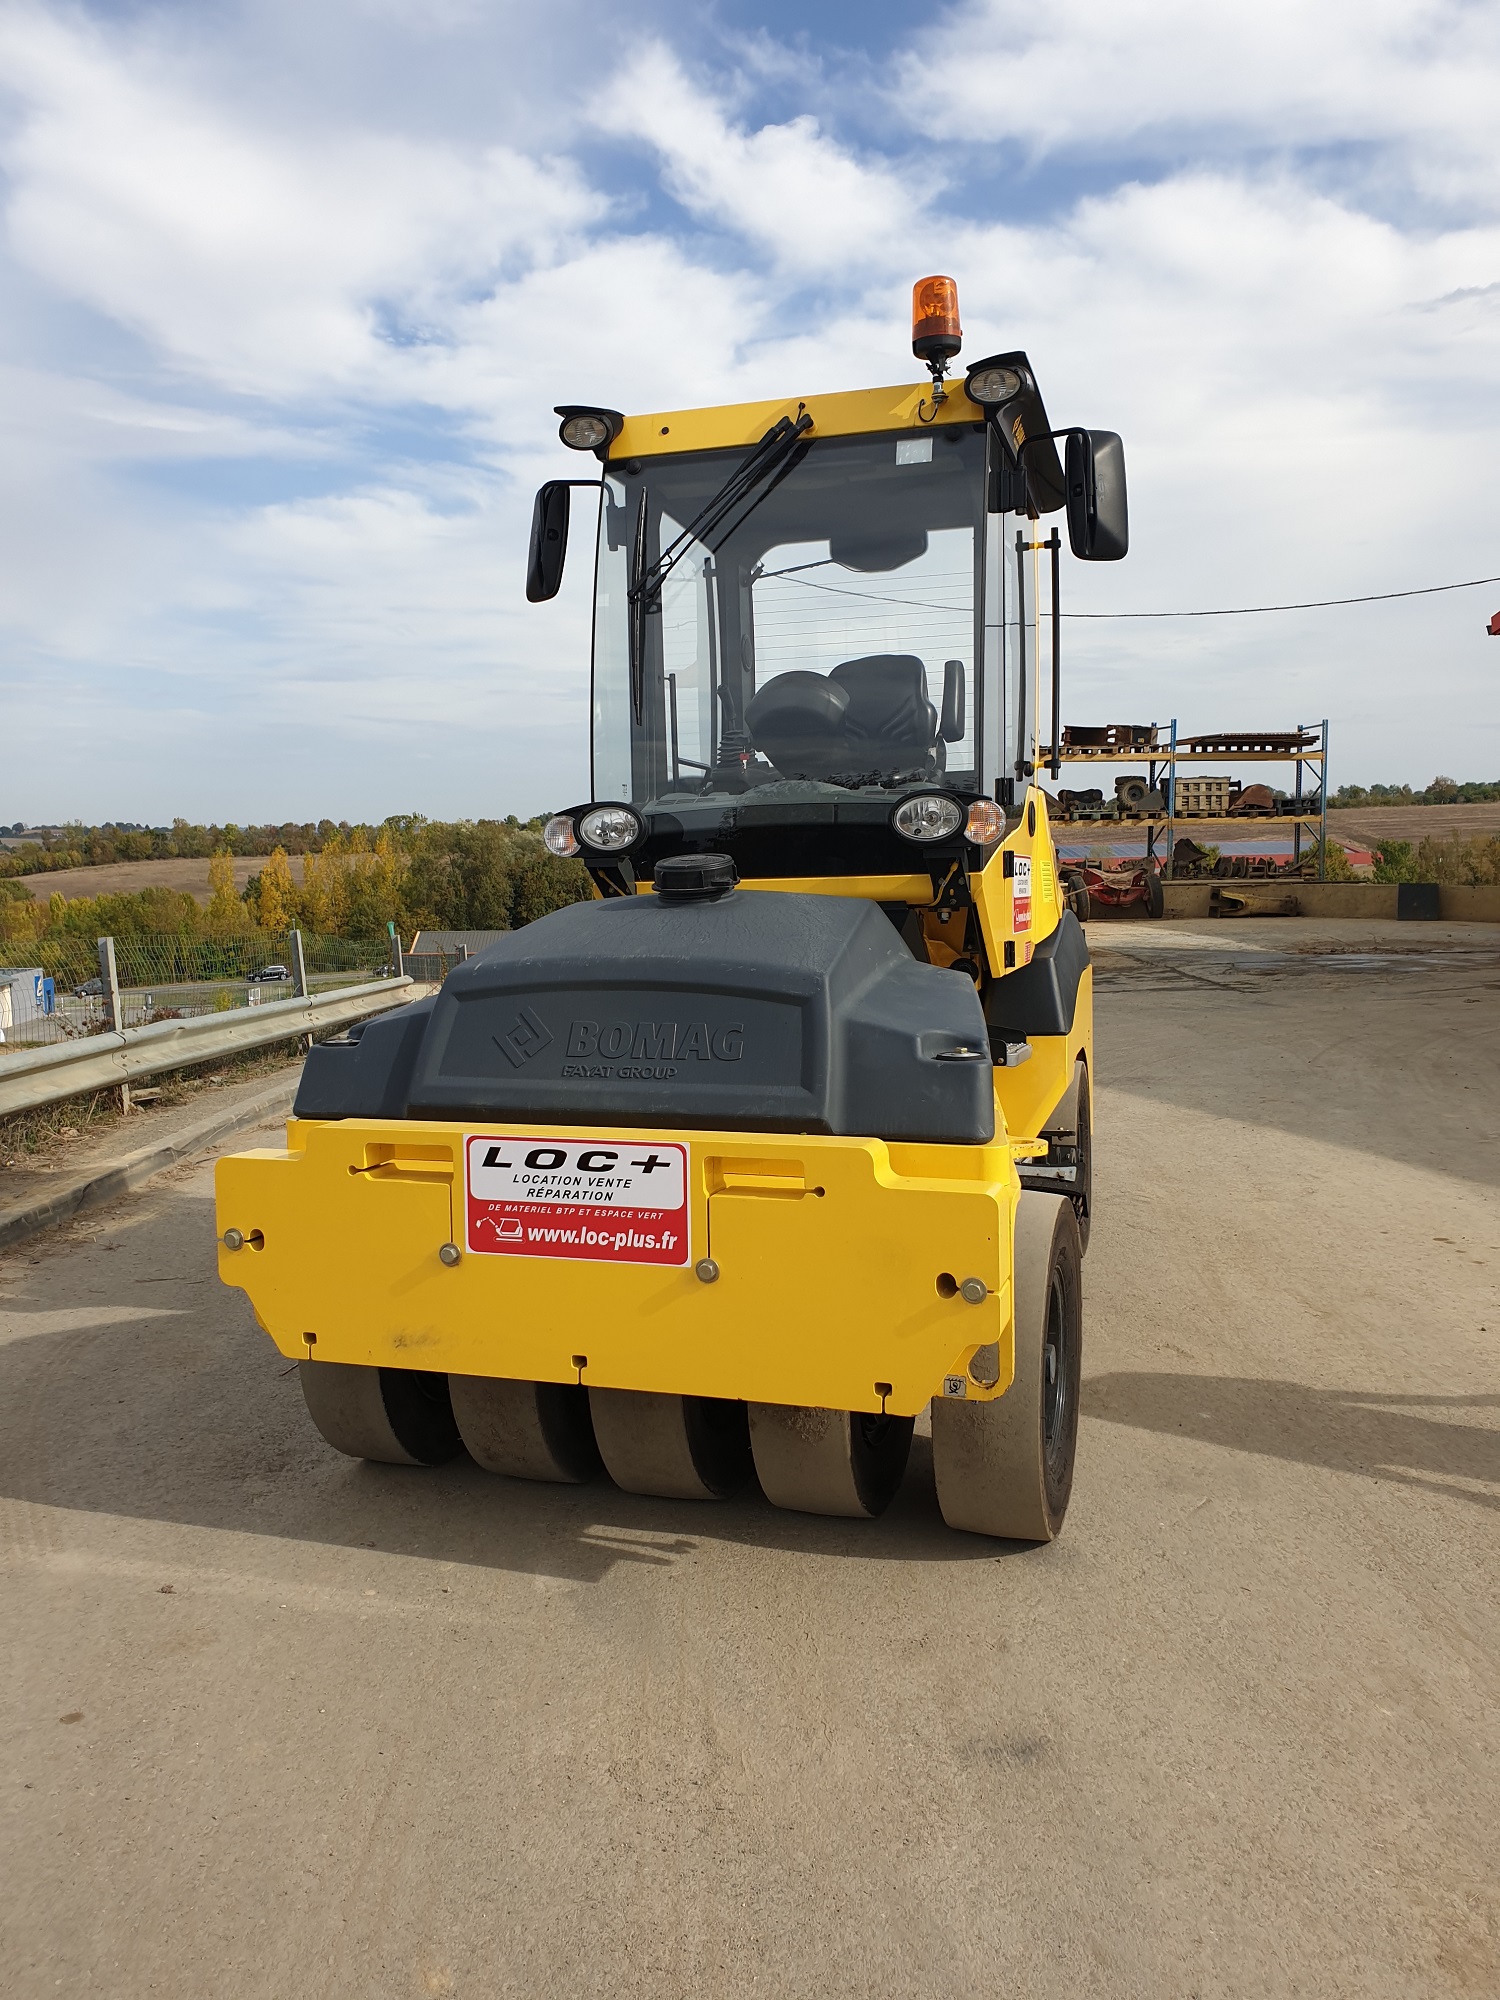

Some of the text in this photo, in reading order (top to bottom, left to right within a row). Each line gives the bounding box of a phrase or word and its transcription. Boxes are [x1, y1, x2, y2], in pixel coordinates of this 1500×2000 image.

[566, 1020, 744, 1061] BOMAG
[562, 1064, 678, 1079] FAYAT GROUP
[482, 1146, 671, 1174] LOC+
[512, 1174, 633, 1189] LOCATION VENTE
[526, 1187, 614, 1202] RÉPARATION
[488, 1203, 664, 1220] DE MATERIEL BTP ET ESPACE VERT
[527, 1225, 678, 1251] www.loc-plus.fr
